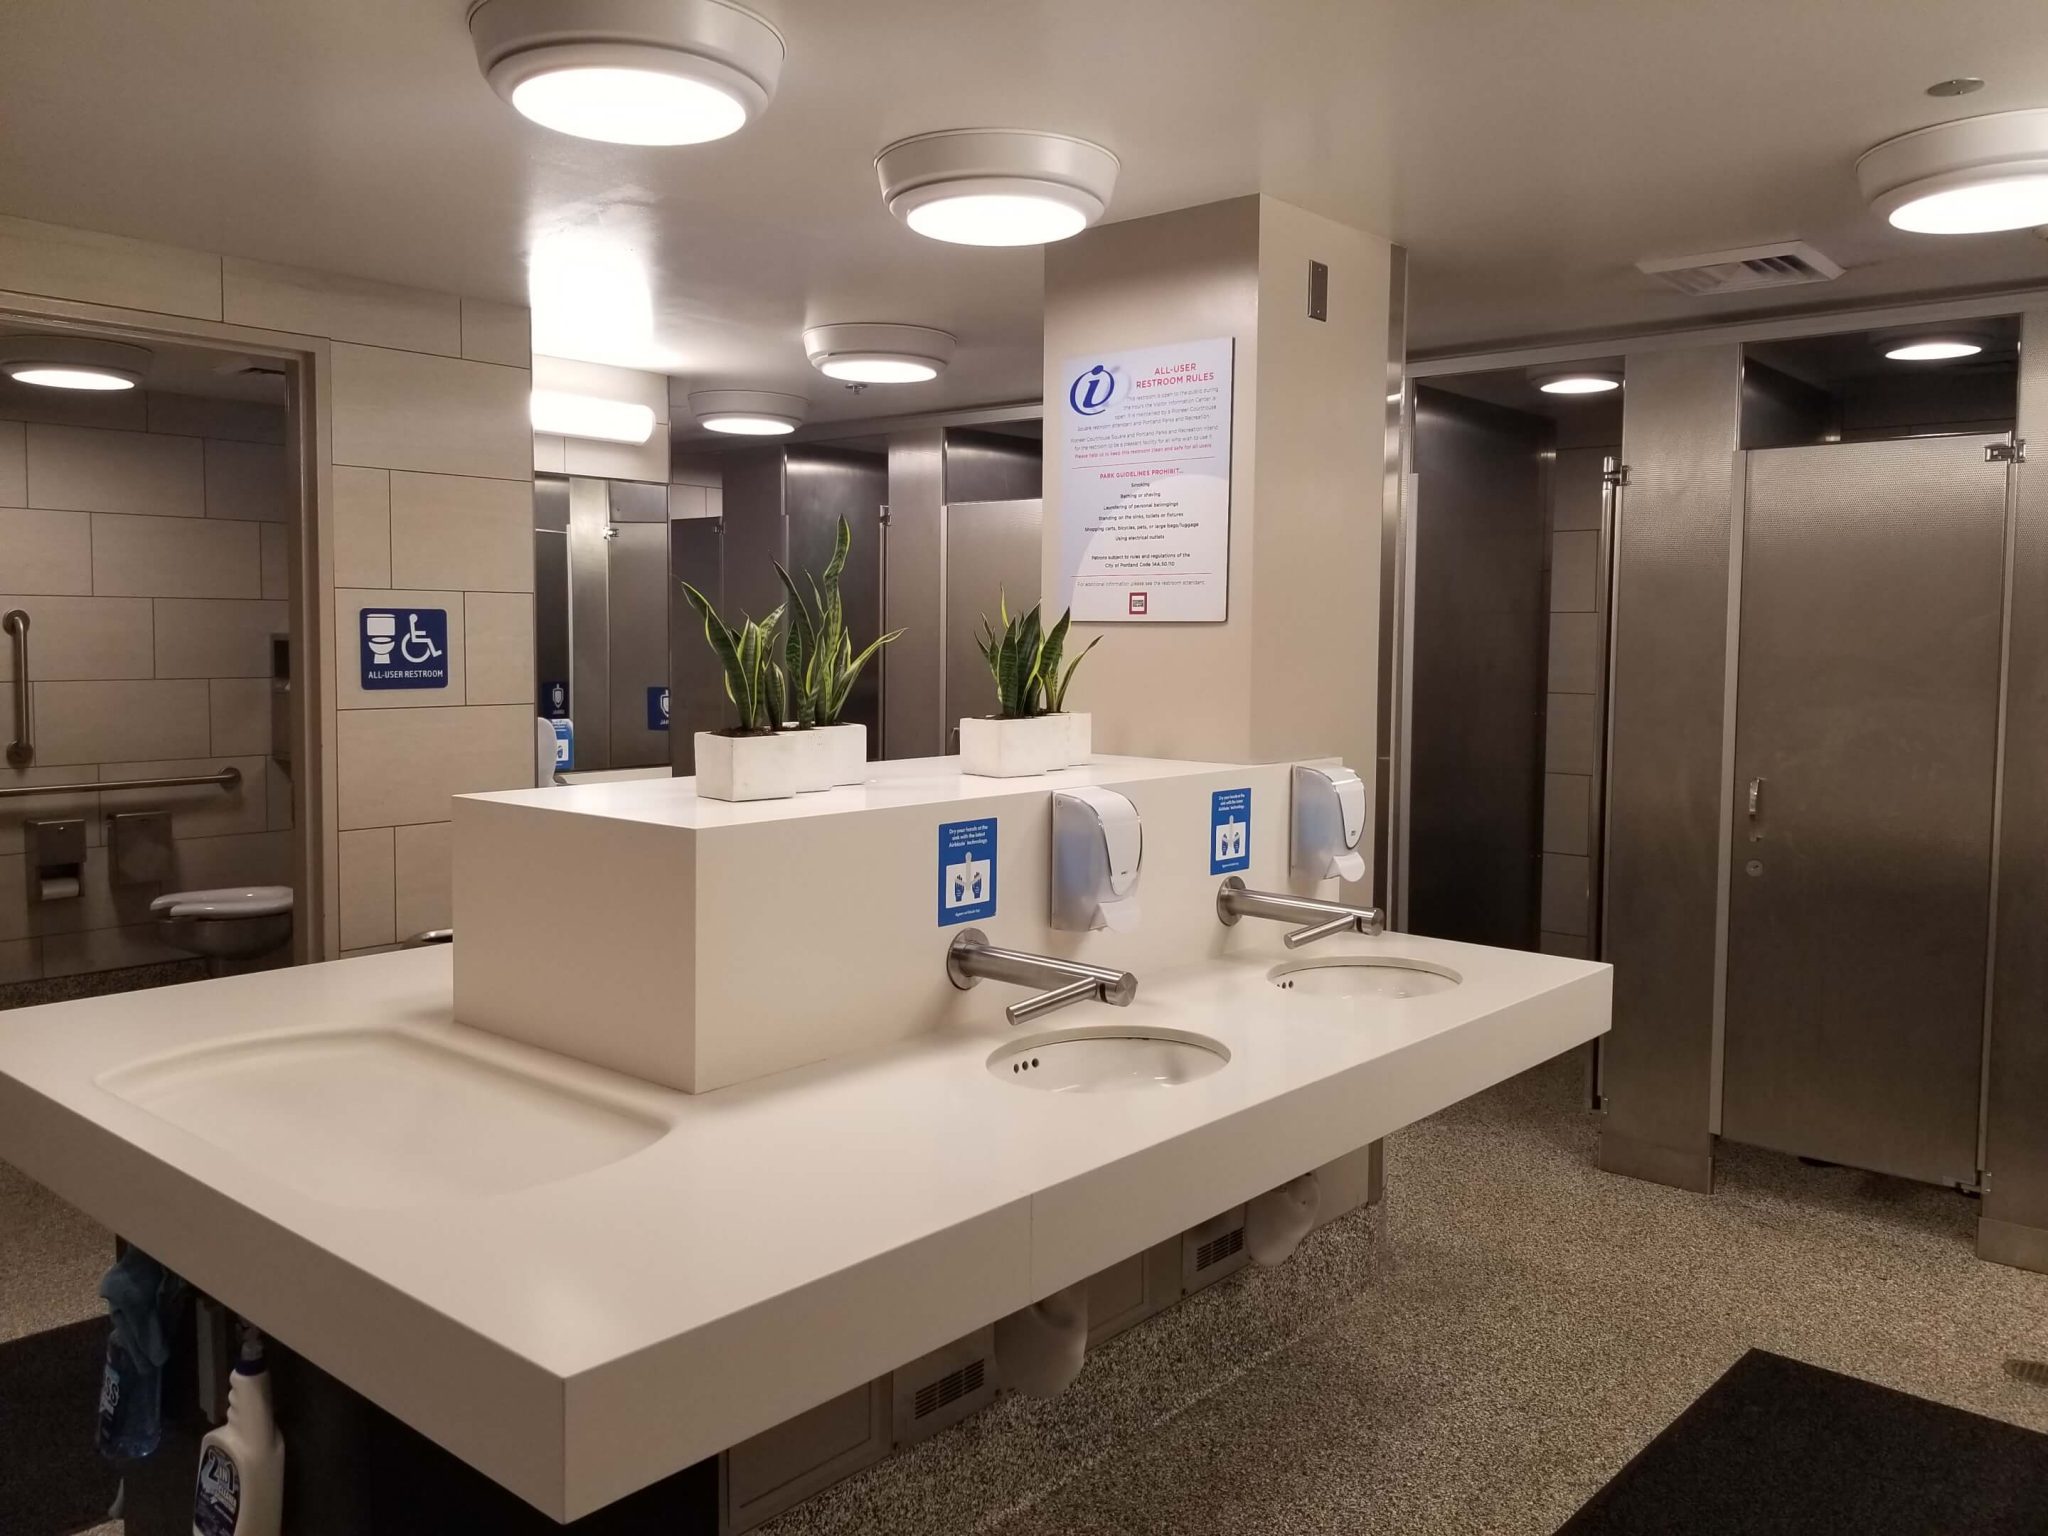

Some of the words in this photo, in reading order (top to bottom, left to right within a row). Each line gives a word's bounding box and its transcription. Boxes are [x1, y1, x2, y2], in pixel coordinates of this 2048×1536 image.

[1154, 362, 1196, 374] ALL-USER
[1136, 376, 1184, 388] RESTROOM
[1186, 372, 1214, 382] RULES
[368, 670, 403, 679] ALL-USER
[404, 670, 443, 678] RESTROOM
